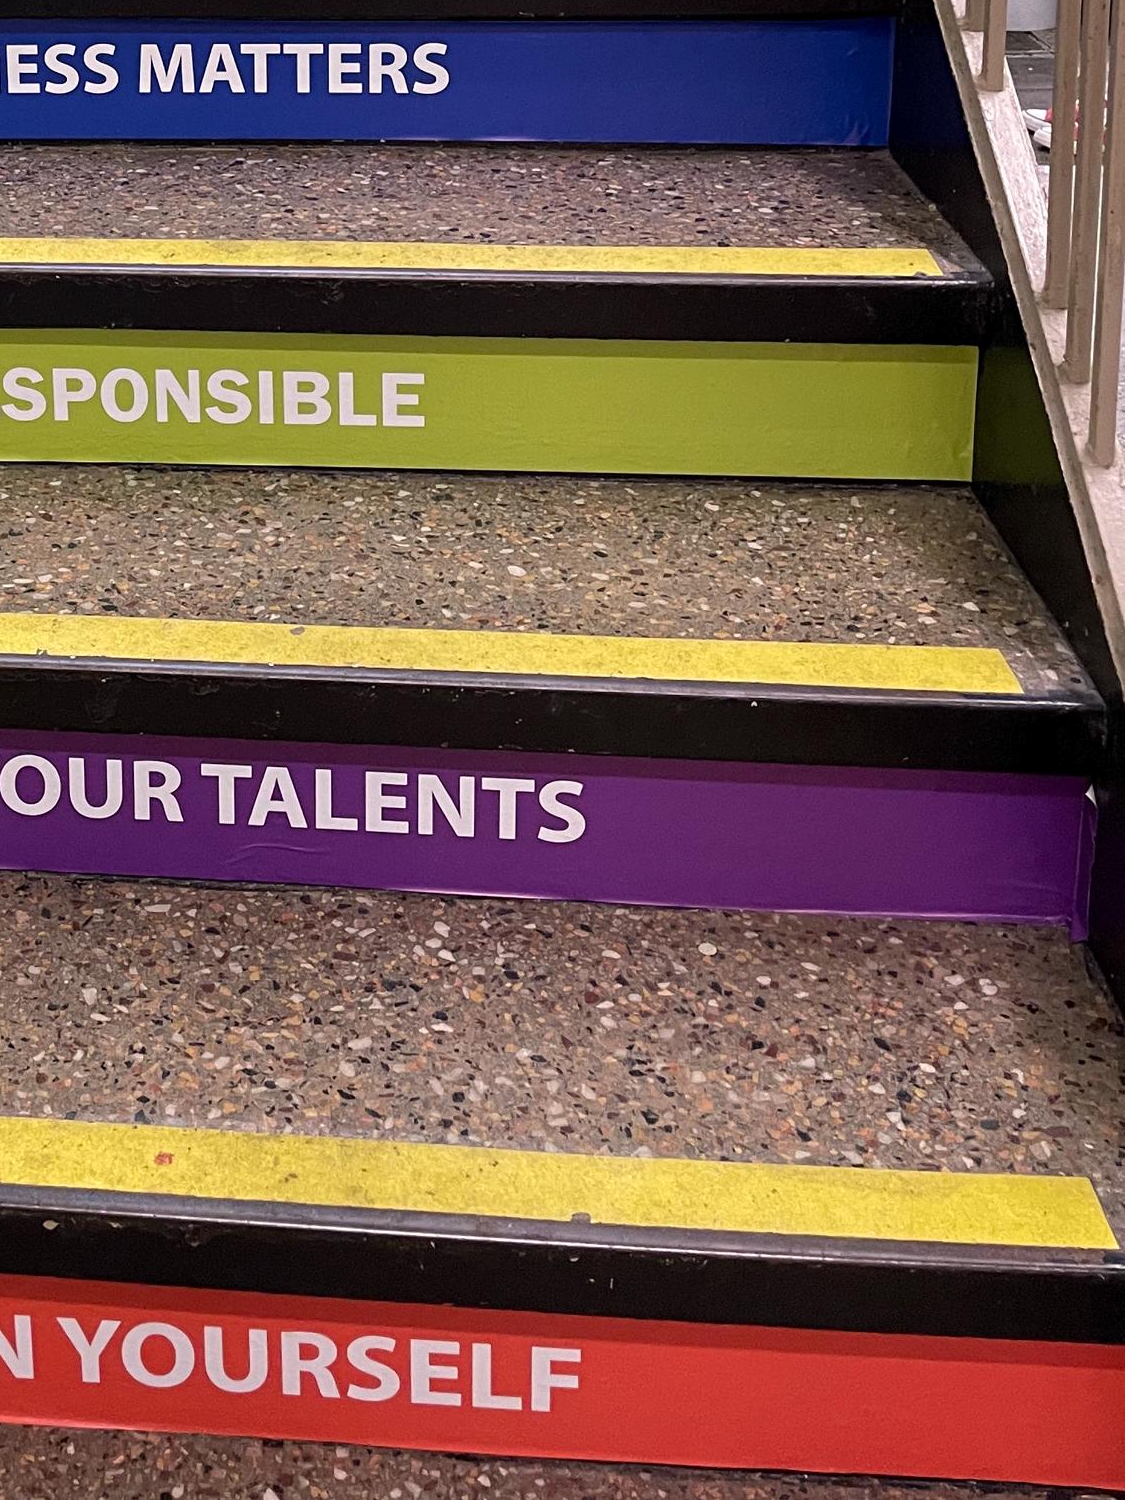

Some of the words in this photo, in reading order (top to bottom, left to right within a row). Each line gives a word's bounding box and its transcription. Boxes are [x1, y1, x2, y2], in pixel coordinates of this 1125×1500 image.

[139, 43, 449, 94] MATTERS
[201, 764, 585, 842] TALENTS
[57, 1318, 581, 1411] YOURSELF
